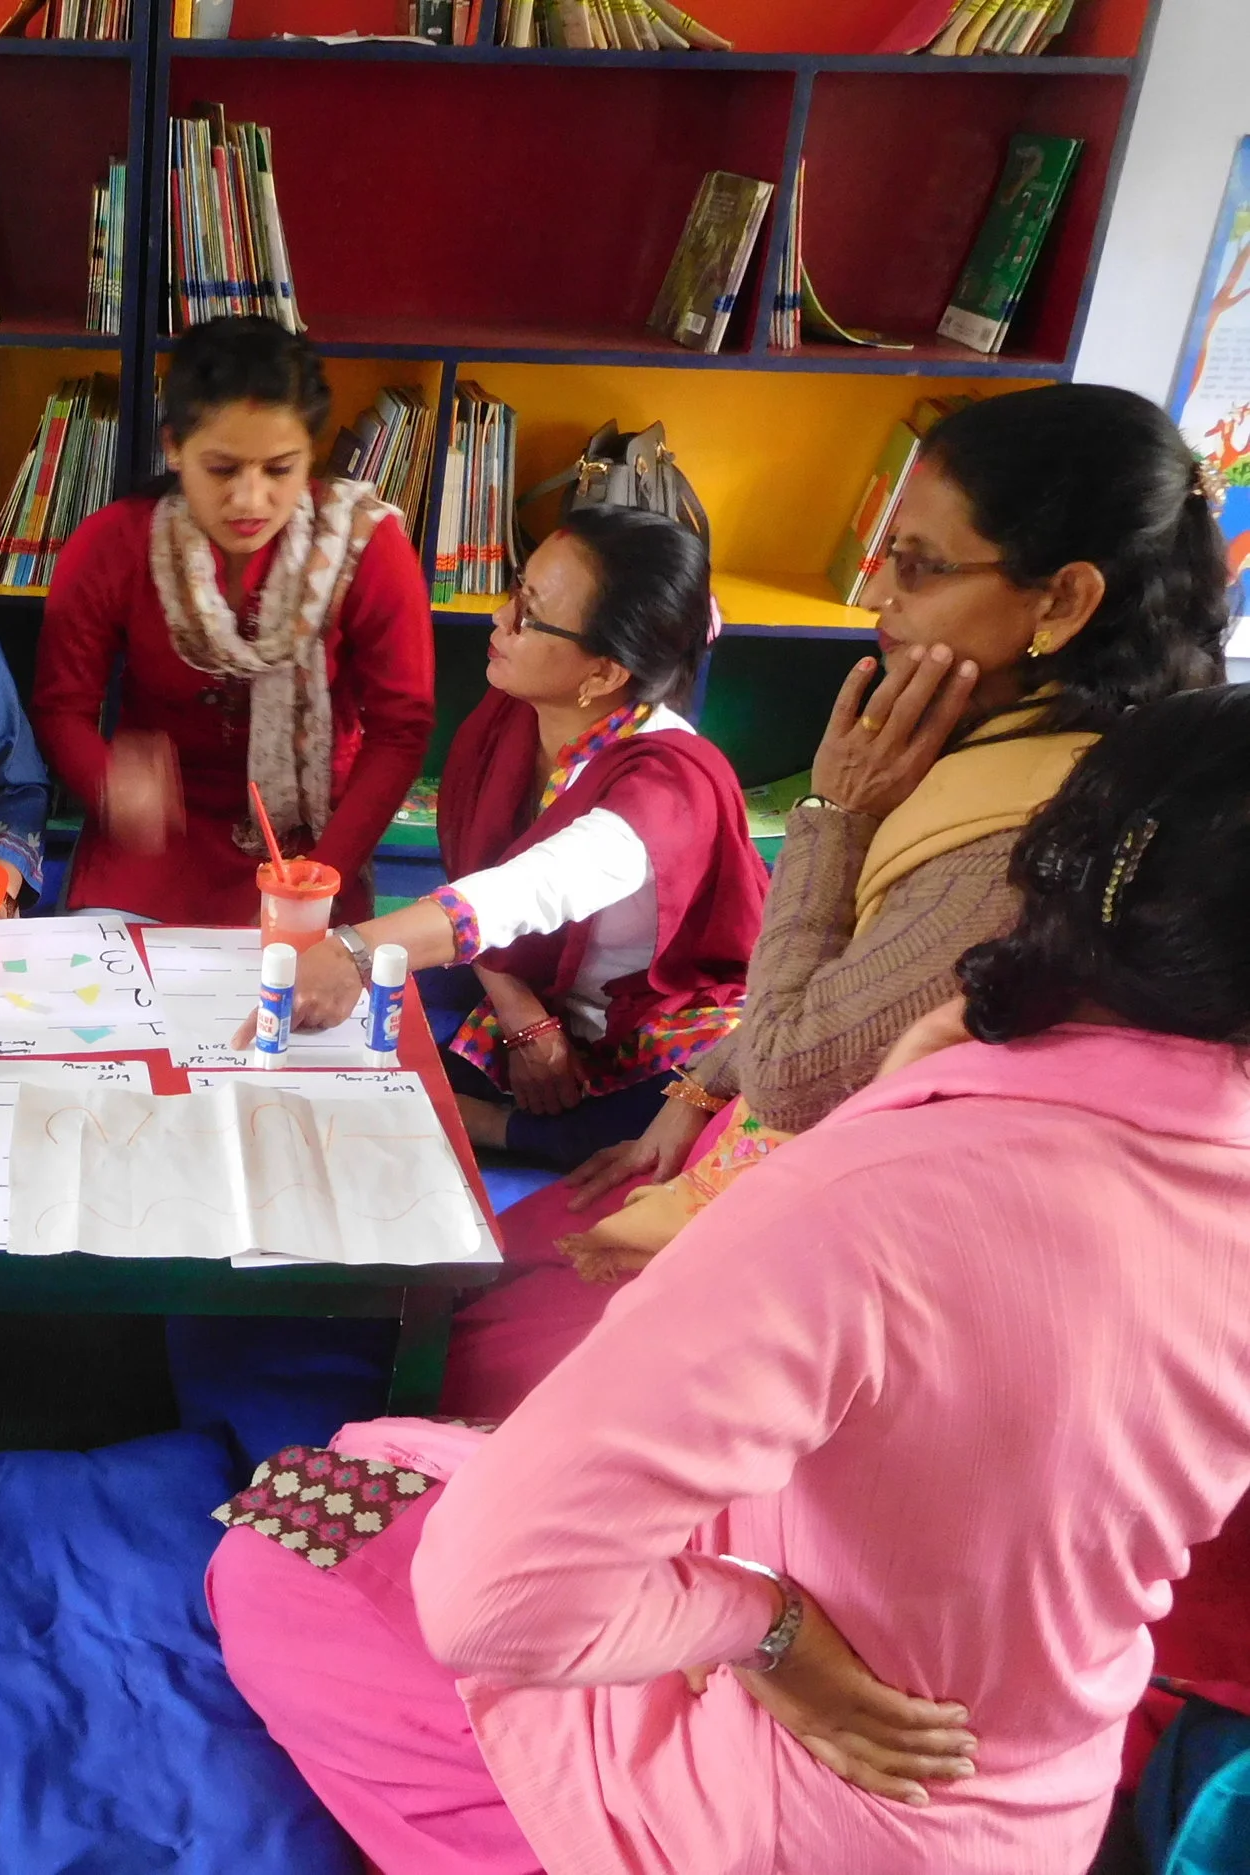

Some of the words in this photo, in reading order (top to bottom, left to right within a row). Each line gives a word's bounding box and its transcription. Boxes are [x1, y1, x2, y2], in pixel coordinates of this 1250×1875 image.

[99, 949, 135, 975] 3
[97, 1073, 131, 1082] 2019
[383, 1084, 416, 1093] 2019
